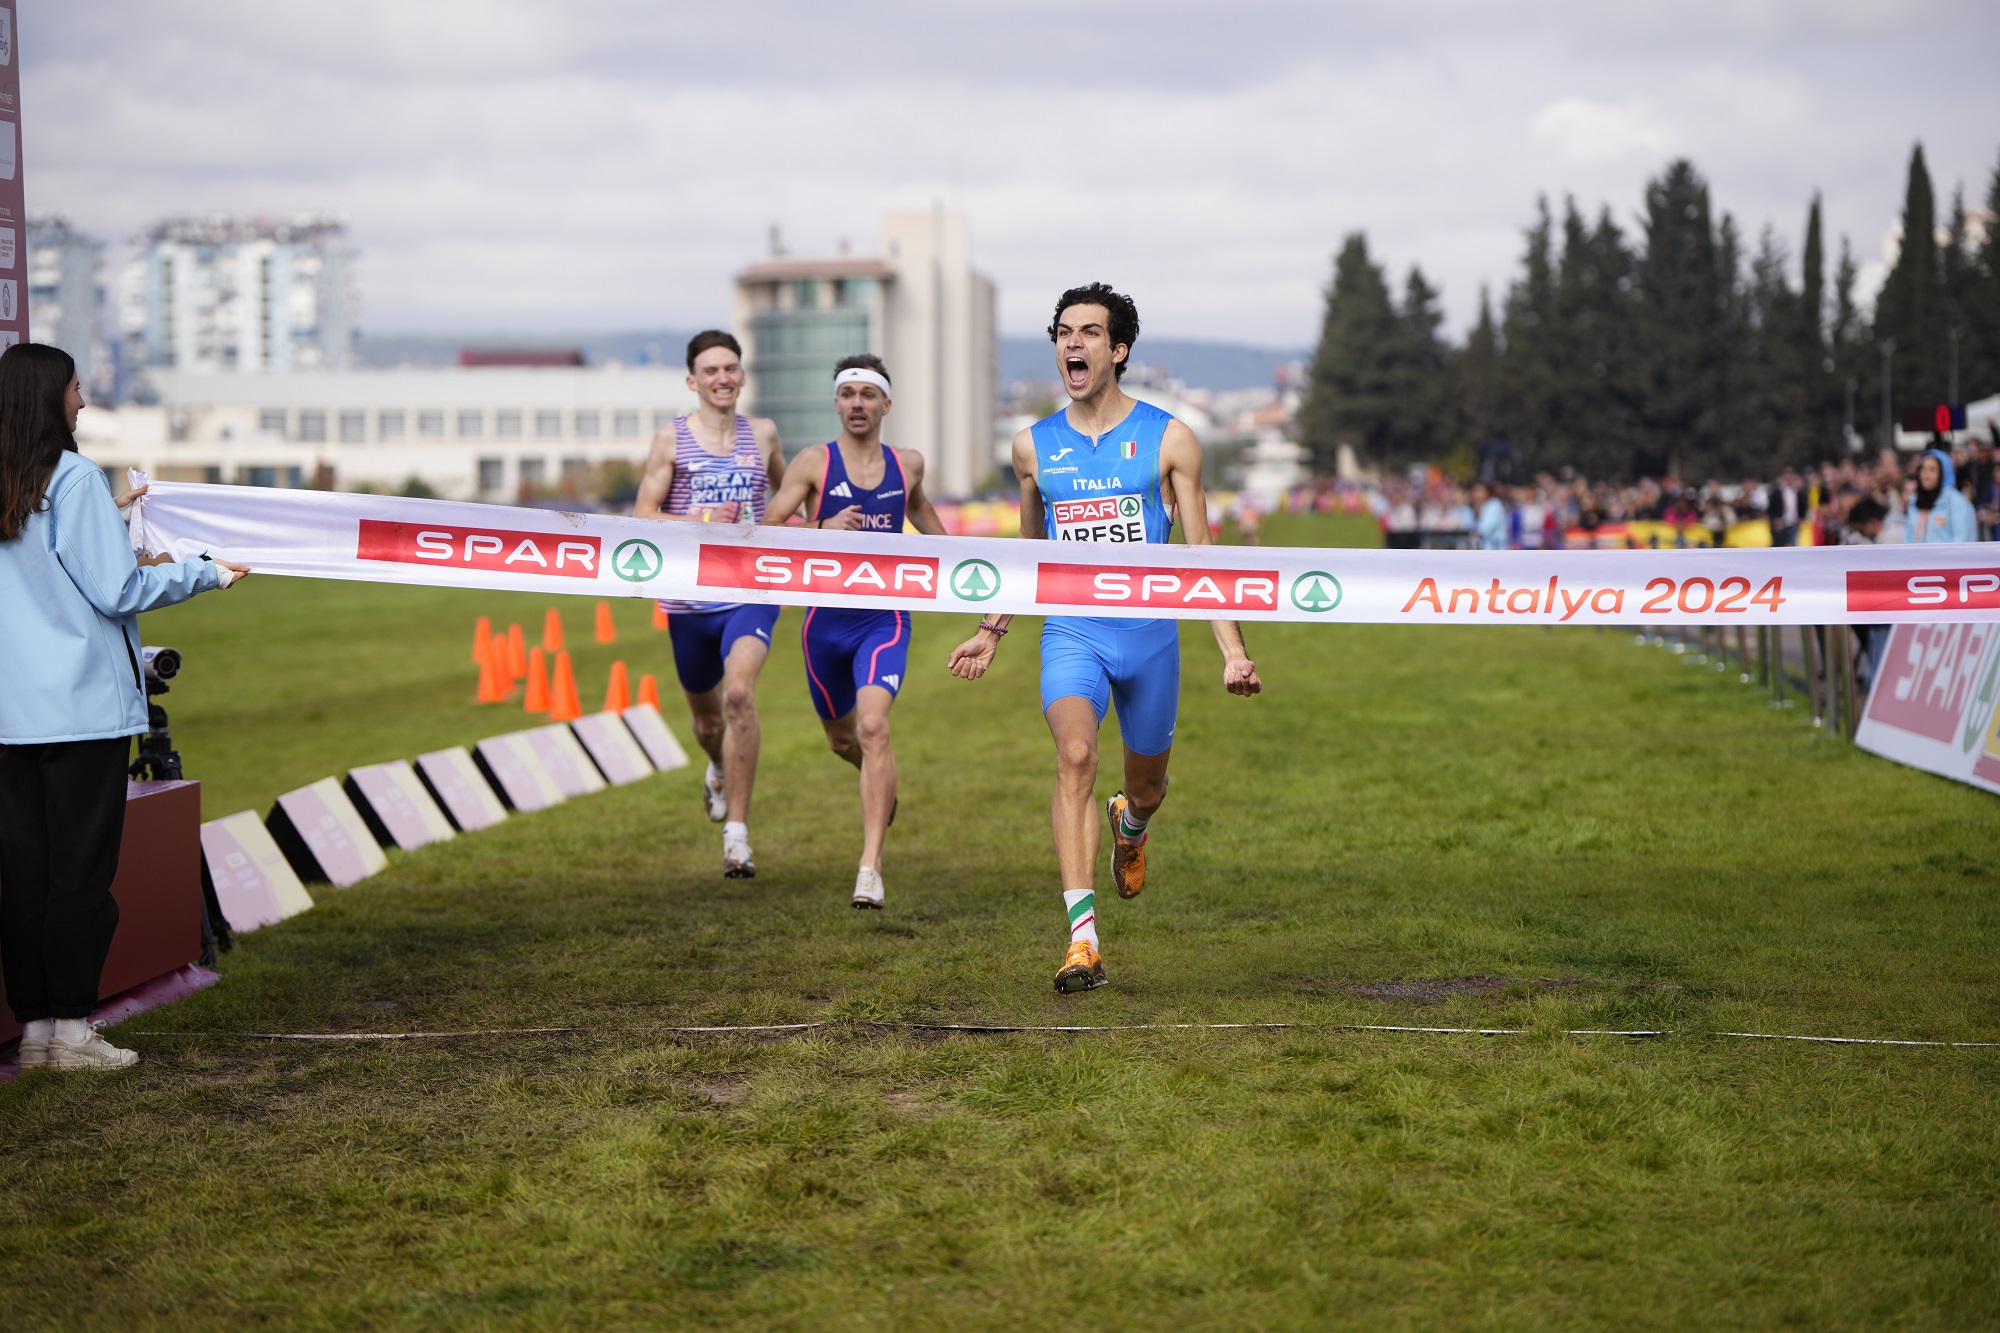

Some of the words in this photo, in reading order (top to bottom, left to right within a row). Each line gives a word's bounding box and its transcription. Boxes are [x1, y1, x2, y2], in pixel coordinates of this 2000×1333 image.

[690, 472, 754, 490] GREAT
[691, 487, 753, 503] BRITAIN
[1072, 476, 1123, 491] ITALIA
[1056, 501, 1117, 522] SPAR
[415, 530, 596, 572] SPAR
[754, 555, 935, 592] SPAR
[1092, 572, 1275, 605] SPAR
[1401, 575, 1625, 621] Antalya
[1640, 576, 1786, 614] 2024
[1895, 622, 1987, 716] SPAR
